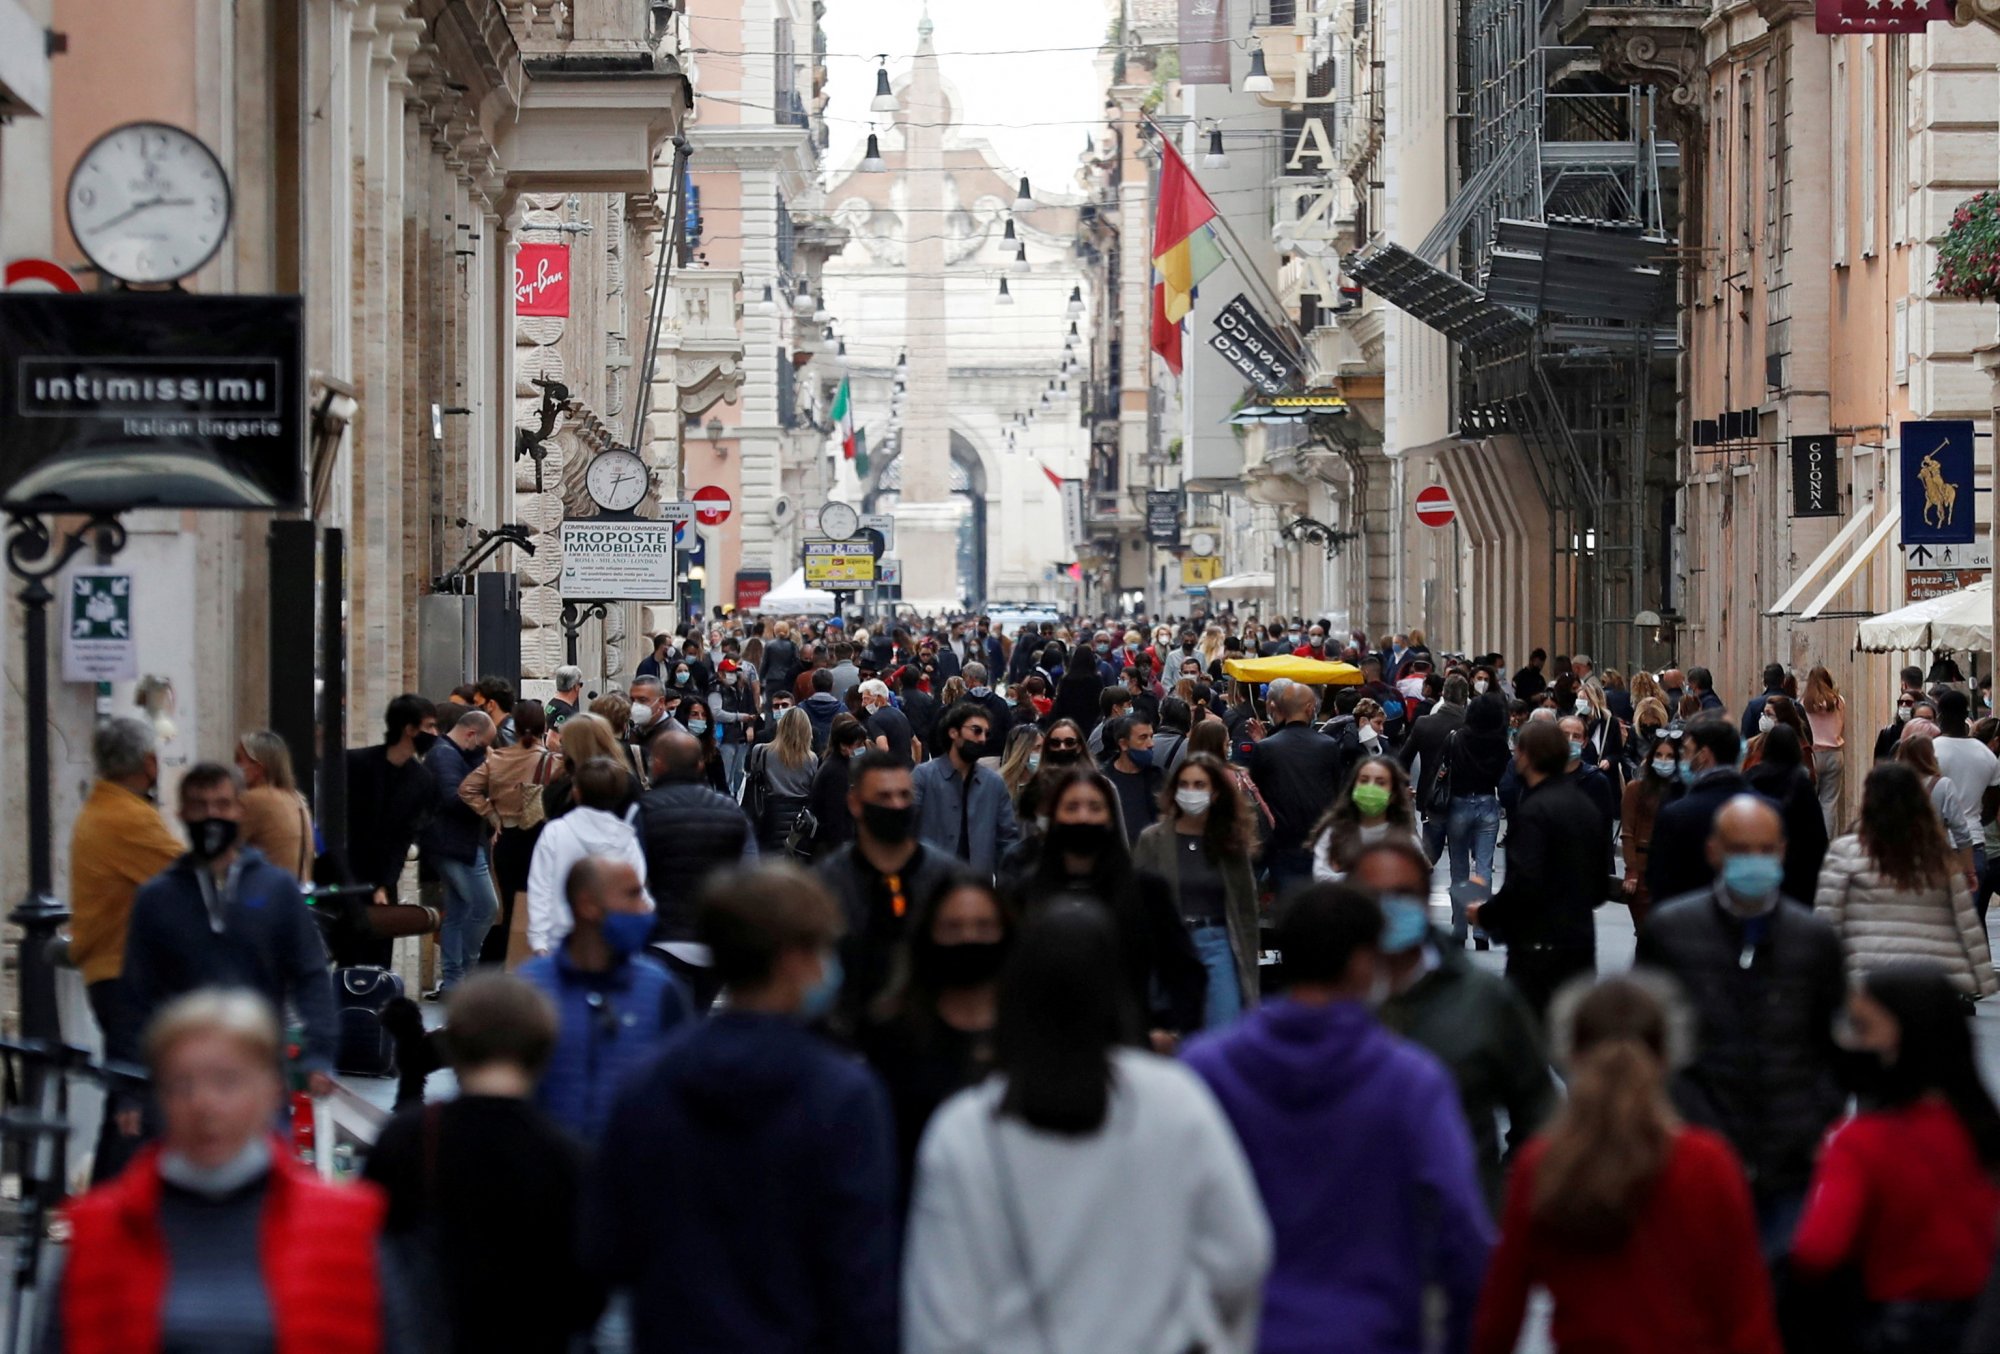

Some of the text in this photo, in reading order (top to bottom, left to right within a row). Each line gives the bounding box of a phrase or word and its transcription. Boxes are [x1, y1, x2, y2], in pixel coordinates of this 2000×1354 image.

[35, 375, 265, 400] intimissimi
[124, 420, 280, 440] Italian lingerie
[1809, 442, 1822, 510] COLONNA
[565, 532, 666, 543] PROPOSTE
[564, 543, 666, 553] IMMOBILIARI
[1911, 575, 1943, 587] piazza
